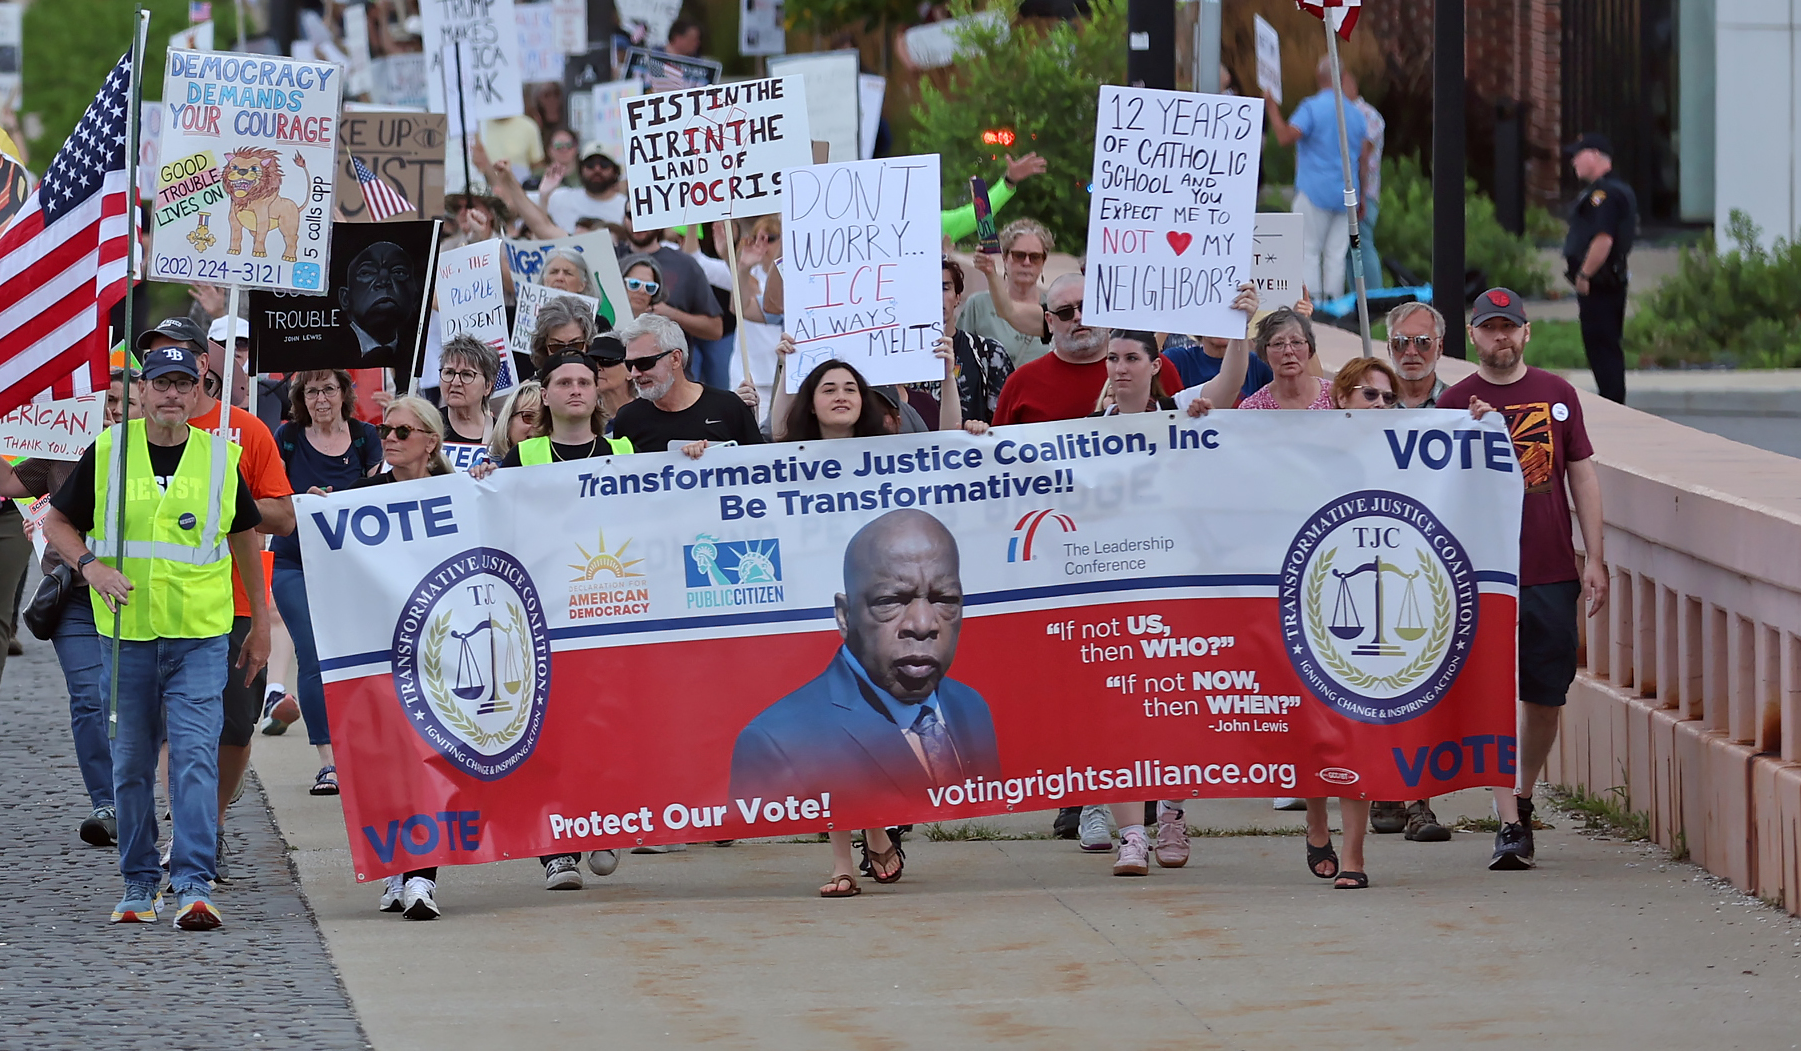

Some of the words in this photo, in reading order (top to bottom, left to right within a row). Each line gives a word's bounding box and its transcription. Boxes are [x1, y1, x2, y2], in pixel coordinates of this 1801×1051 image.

[440, 17, 498, 46] MAKES
[171, 53, 334, 91] DEMOCRACY
[187, 81, 304, 112] DEMANDS
[170, 103, 221, 134] YOUR
[234, 110, 332, 142] COURAGE
[1112, 93, 1145, 131] 12
[1157, 99, 1252, 141] YEARS
[378, 119, 412, 148] UP
[161, 154, 207, 182] GOOD
[652, 158, 708, 181] LAND
[722, 151, 747, 170] OF
[1103, 134, 1129, 153] OF
[1137, 138, 1247, 177] CATHOLIC
[159, 168, 220, 203] TROUBLE
[312, 176, 331, 202] app
[790, 162, 927, 221] DON'T
[1102, 159, 1173, 194] SCHOOL
[1180, 173, 1216, 188] AND
[155, 198, 199, 227] LIVES
[203, 185, 224, 205] ON
[634, 172, 782, 216] HYPOCRIS
[1191, 188, 1221, 205] YOU
[306, 208, 322, 241] calls
[1174, 207, 1199, 223] ME
[1208, 208, 1230, 225] TO
[304, 248, 318, 259] 5
[792, 220, 925, 272] WORRY...
[1103, 228, 1154, 254] NOT
[1202, 232, 1235, 256] MY
[155, 253, 192, 277] (202)
[198, 259, 281, 284] 224-3121
[467, 254, 490, 269] THE
[804, 263, 898, 310] ICE
[265, 309, 340, 329] TROUBLE
[447, 304, 503, 335] DISSENT
[794, 306, 897, 341] ALWAYS
[163, 348, 183, 361] TB
[868, 321, 944, 357] MELTS
[4, 436, 42, 451] THANK
[1384, 428, 1514, 472] VOTE
[578, 456, 842, 499] Transformative
[852, 444, 983, 478] Justice
[993, 429, 1156, 466] Coalition,
[1169, 424, 1220, 450] Inc
[720, 494, 767, 521] Be
[777, 467, 1075, 516] Transformative!!
[311, 495, 459, 550] VOTE
[1353, 527, 1401, 548] TJC
[1063, 543, 1090, 557] The
[1094, 536, 1174, 555] Leadership
[1064, 558, 1146, 576] Conference
[1287, 498, 1367, 640] TRANSFORMATIVE
[1371, 497, 1432, 536] JUSTICE
[1433, 535, 1472, 636] COALITION
[467, 584, 495, 606] TJC
[568, 582, 625, 593] DECLARATION
[629, 579, 647, 587] FOR
[568, 588, 649, 607] AMERICAN
[569, 603, 650, 619] DEMOCRACY
[1082, 618, 1120, 639] not
[1127, 614, 1171, 637] US,
[398, 554, 480, 708] TRANSFORMATIVE
[523, 588, 547, 692] COALITION
[1080, 643, 1133, 663] then
[1144, 673, 1185, 692] not
[1192, 670, 1260, 693] NOW,
[1299, 660, 1336, 701] IGNITING
[1337, 697, 1377, 718] CHANGE
[1379, 710, 1386, 718] &
[1388, 693, 1435, 717] INSPIRING
[1434, 655, 1460, 694] ACTION
[1143, 698, 1198, 717] then
[1254, 719, 1289, 733] Lewis
[425, 724, 465, 762] IGNITING
[489, 767, 495, 775] &
[495, 747, 528, 774] INSPIRING
[527, 710, 541, 749] ACTION
[1391, 734, 1517, 789] VOTE
[927, 760, 1297, 808] votingrightsalliance.org
[549, 807, 654, 840] Protect
[663, 802, 727, 830] Our
[736, 792, 831, 825] Vote!
[362, 811, 481, 864] VOTE
